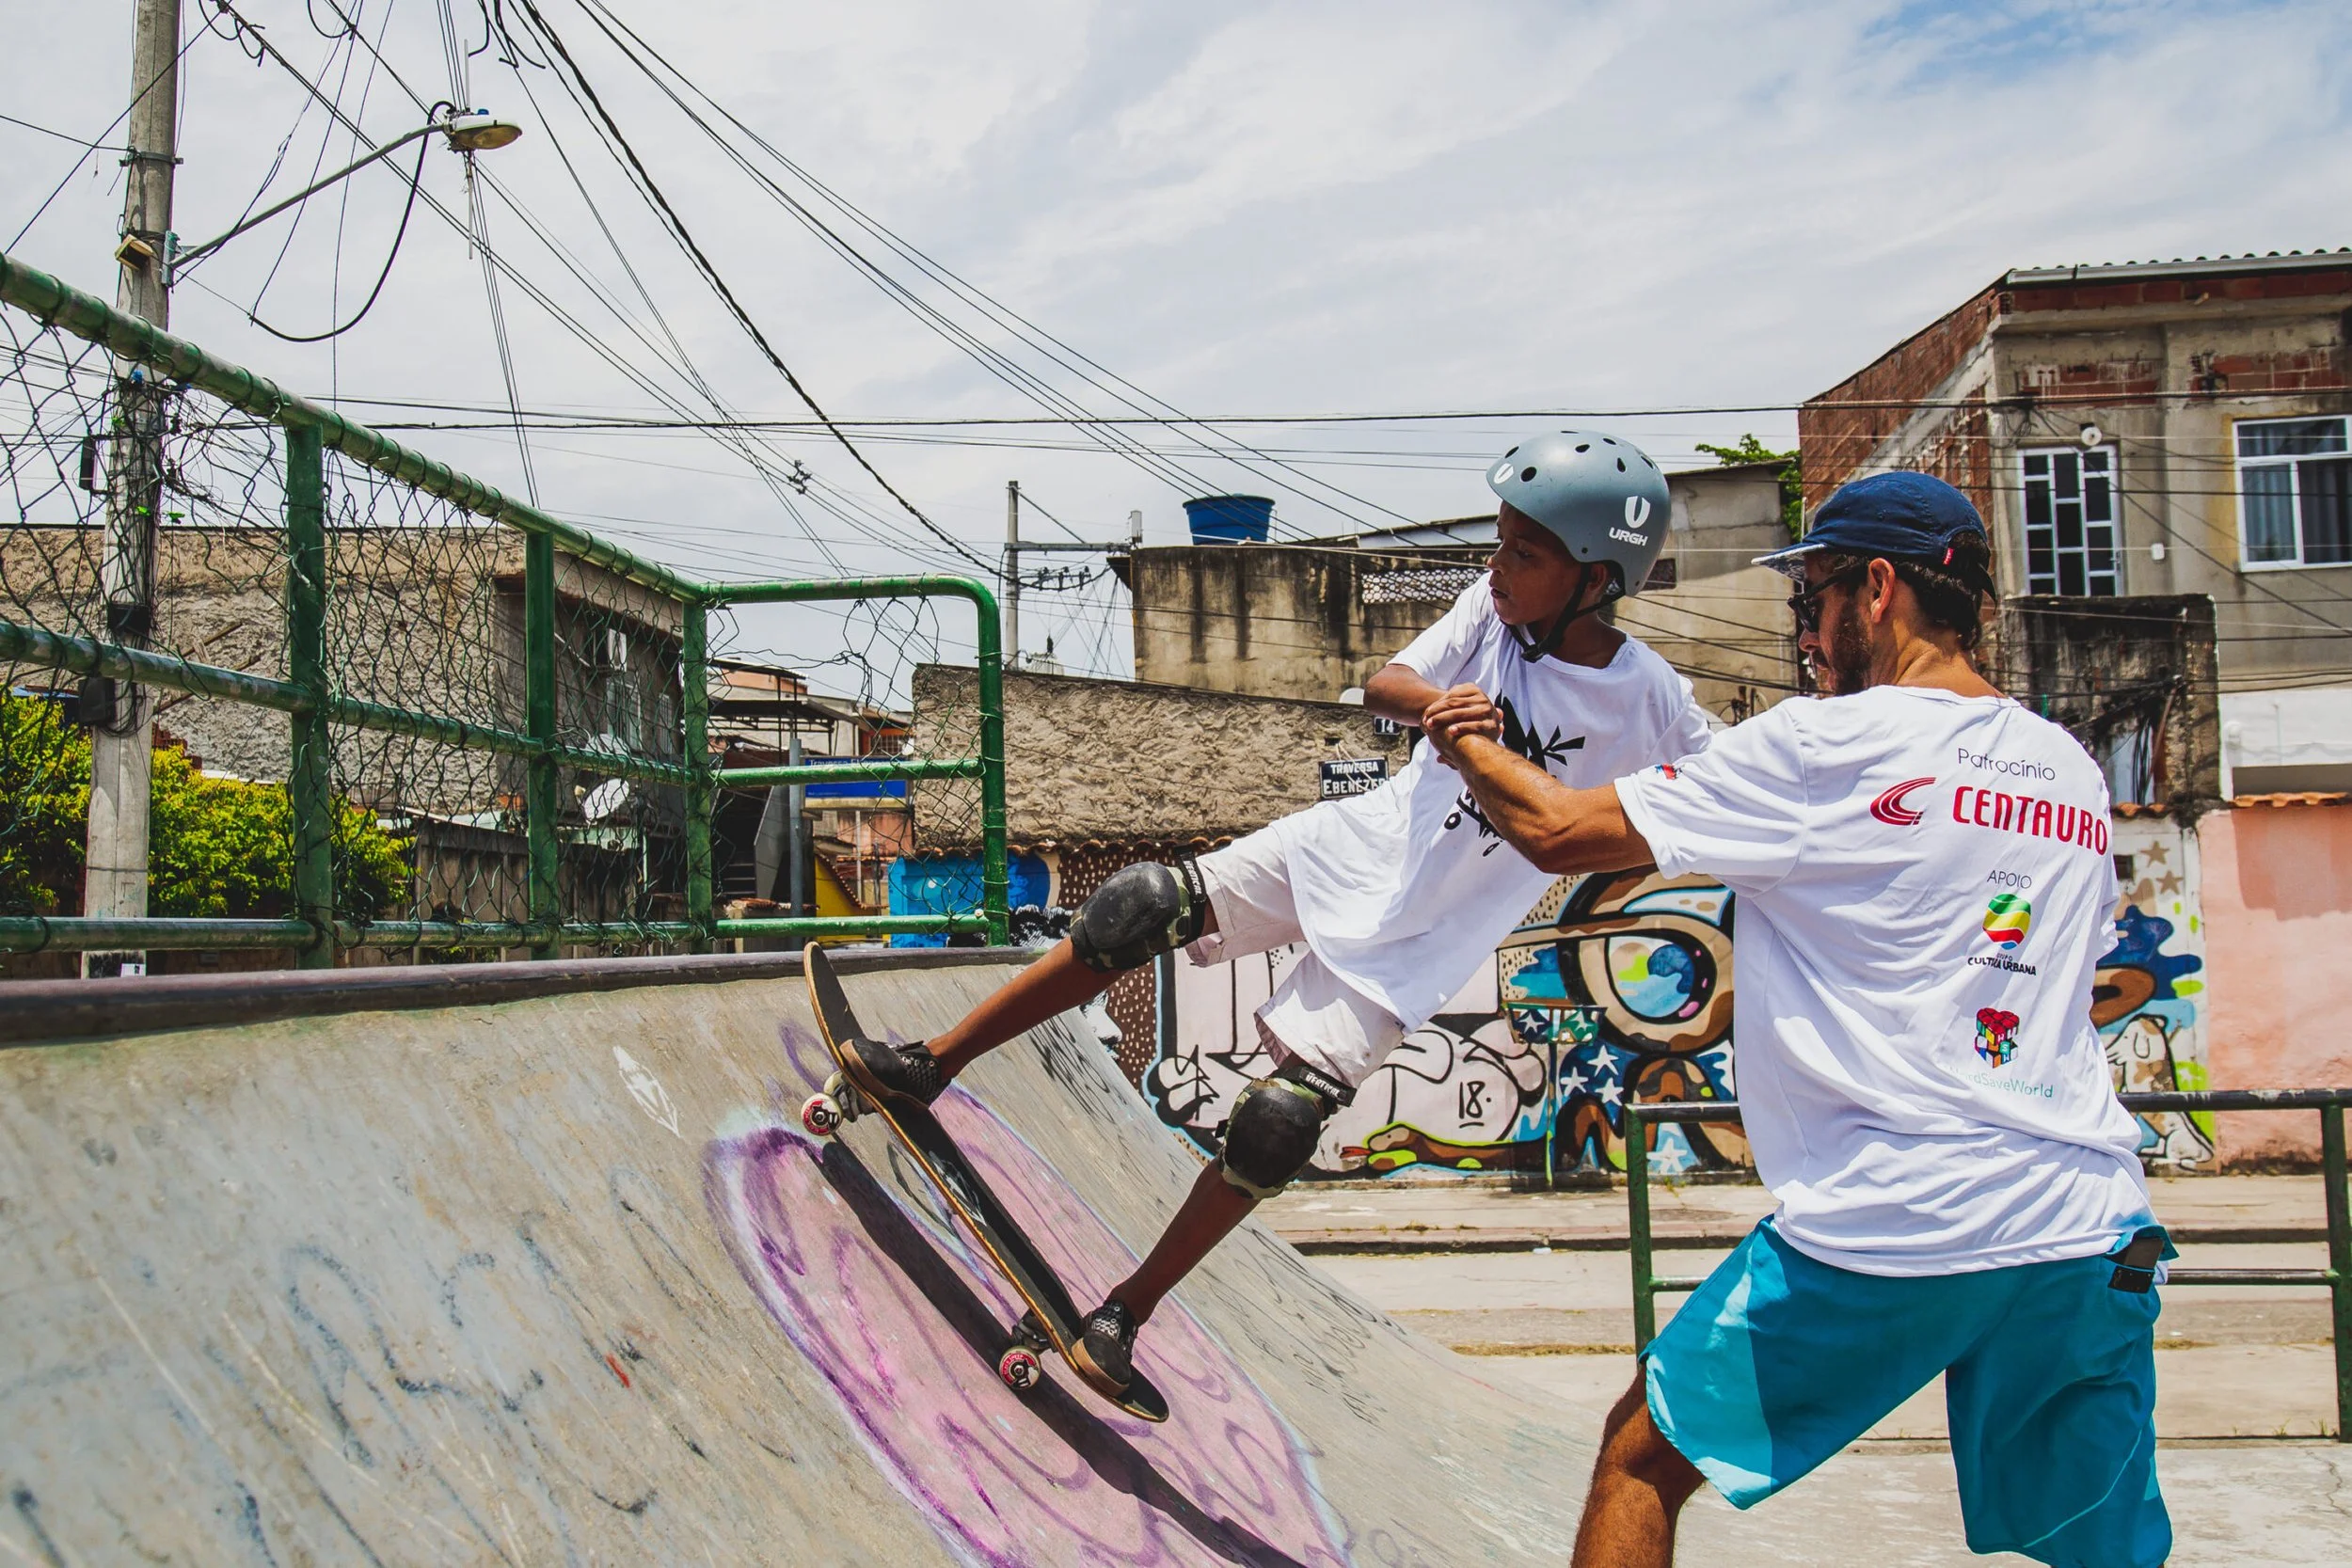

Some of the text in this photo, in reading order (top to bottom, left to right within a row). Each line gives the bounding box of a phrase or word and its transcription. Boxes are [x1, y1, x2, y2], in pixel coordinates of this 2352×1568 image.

[1608, 527, 1648, 546] URGH
[1380, 719, 1394, 733] 14
[1329, 761, 1379, 775] TRAVESSA
[1958, 748, 2056, 782] Patrocínio
[1952, 785, 2108, 856] CENTAURO
[1986, 869, 2032, 890] APOIO
[2002, 960, 2037, 975] URBANA
[1305, 1071, 1341, 1098] VERTICAL
[1949, 1065, 2053, 1099] rdSaveWorld
